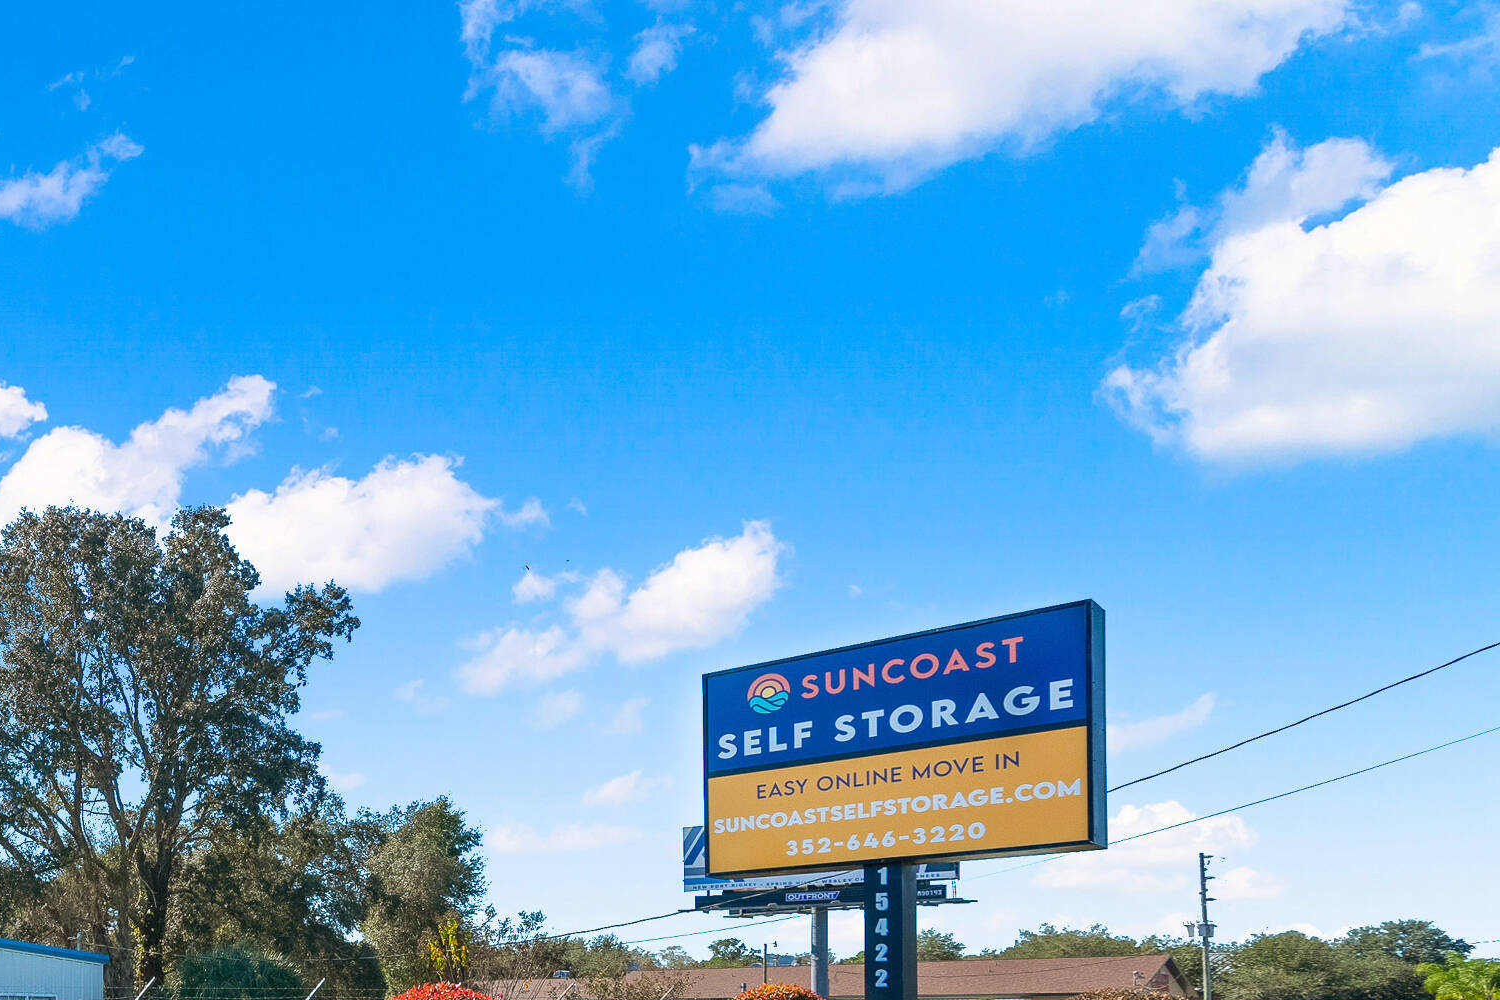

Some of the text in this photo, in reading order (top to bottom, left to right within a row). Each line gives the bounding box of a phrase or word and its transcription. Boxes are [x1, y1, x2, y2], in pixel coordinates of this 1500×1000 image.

[800, 635, 1024, 699] SUNCOAST
[717, 678, 1074, 760] SELF STORAGE
[757, 751, 1020, 800] EASY ONLINE MOVE IN
[713, 778, 1081, 834] SUNCOASTSELFSTORAGE.COM
[786, 821, 986, 857] 352-646-3220
[787, 891, 837, 900] OUTFRONT
